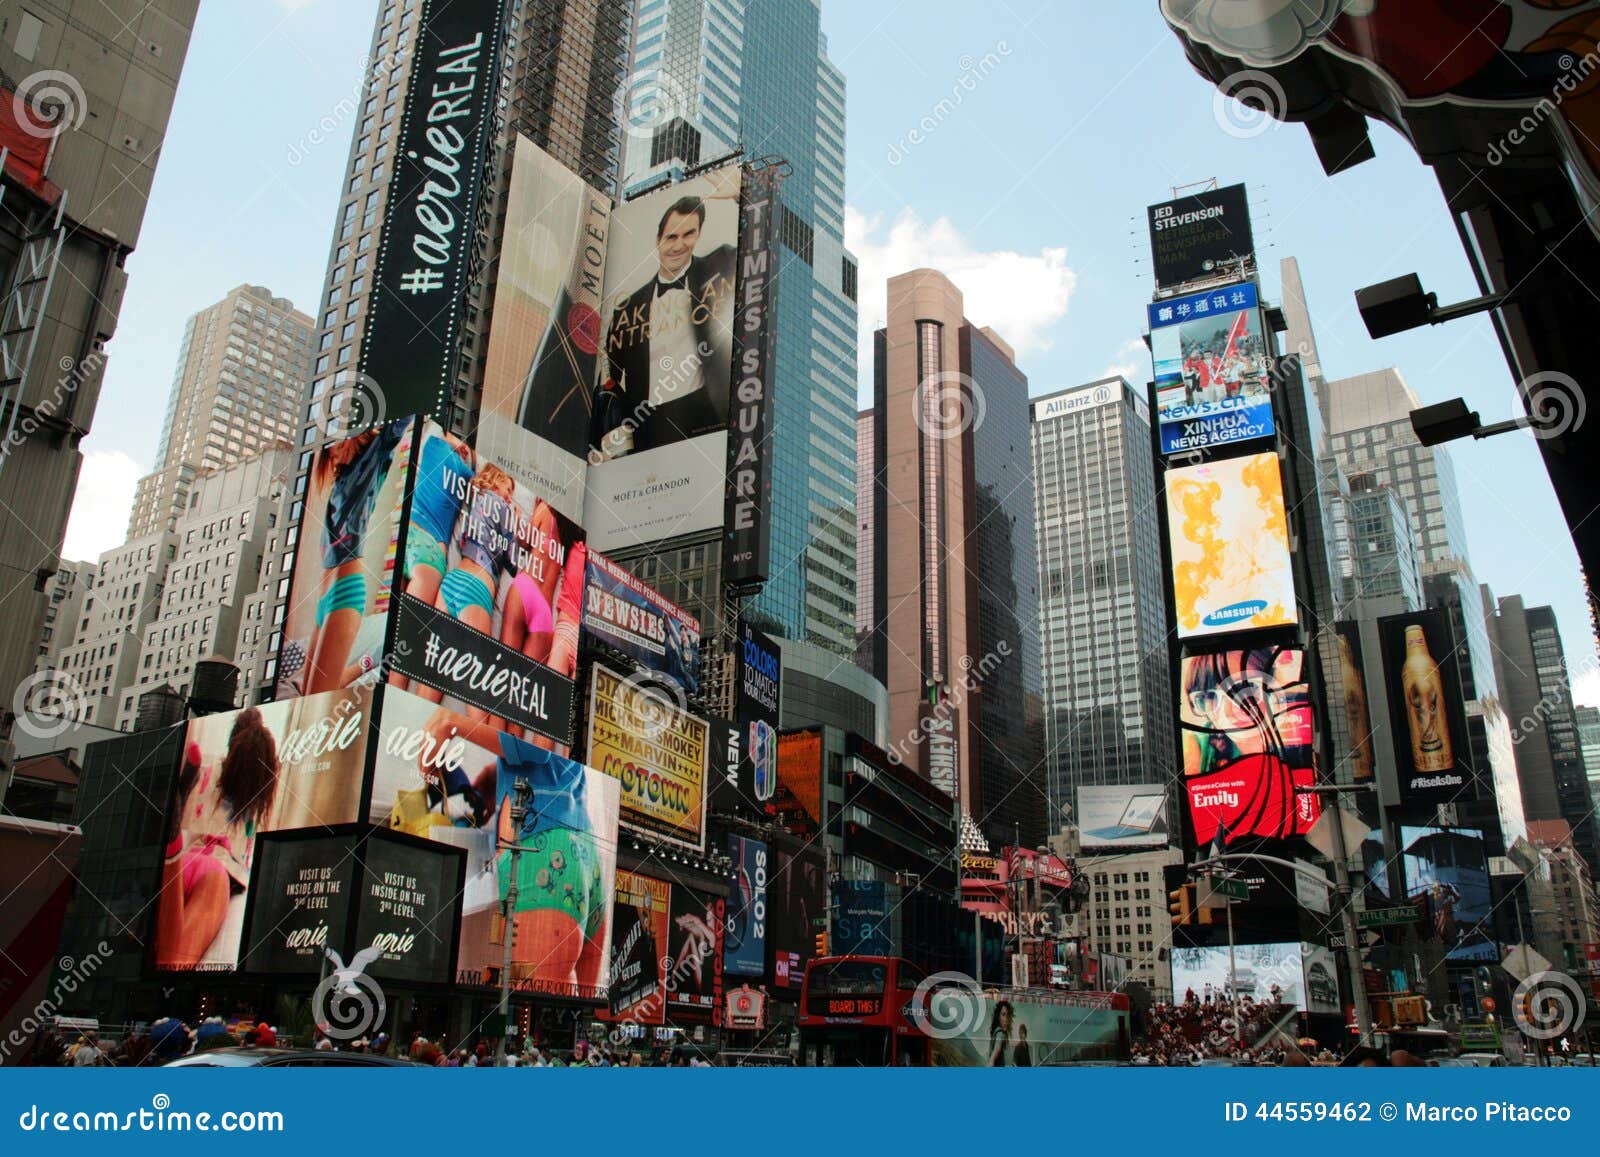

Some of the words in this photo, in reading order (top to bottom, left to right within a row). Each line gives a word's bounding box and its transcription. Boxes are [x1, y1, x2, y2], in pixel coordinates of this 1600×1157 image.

[400, 31, 483, 295] #aerieREAL
[1153, 205, 1174, 221] JED
[1155, 205, 1224, 231] STEVENSON
[743, 199, 769, 332] TIMES
[1158, 291, 1248, 322] 新华通讯社
[1046, 395, 1091, 415] Allianz
[1170, 433, 1208, 450] NEWS
[1210, 423, 1266, 445] AGENCY
[1184, 413, 1250, 436] XINHUA
[734, 348, 763, 531] SQUARE
[527, 471, 568, 497] CHANDON
[645, 476, 691, 496] CHANDON
[442, 466, 480, 504] VISIT
[482, 494, 501, 523] US
[504, 507, 547, 553] INSIDE
[548, 538, 565, 567] ON
[459, 511, 485, 546] THE
[489, 530, 508, 553] 3RD
[510, 545, 545, 583] LEVEL
[732, 551, 753, 563] NYC
[588, 550, 606, 569] FINAL
[630, 574, 643, 593] LAST
[586, 584, 666, 643] NEWSIES
[1210, 605, 1262, 621] SAMSUNG
[743, 640, 778, 682] COLORS
[425, 632, 549, 721] #aerieREAL
[744, 662, 754, 680] TO
[754, 670, 778, 699] MATCH
[278, 710, 363, 765] aerie
[385, 726, 466, 772] aerie
[655, 728, 701, 763] SMOKEY
[621, 732, 678, 771] MARVIN
[726, 728, 740, 789] NEW
[929, 716, 954, 798] RSHEY'S
[603, 753, 690, 815] MOTOWN
[1410, 775, 1463, 789] #RiseAsOne
[1193, 790, 1239, 808] Emily
[300, 868, 319, 881] VISIT
[320, 867, 332, 880] US
[384, 871, 404, 887] VISIT
[406, 877, 417, 890] US
[753, 849, 767, 922] SOLO
[287, 883, 313, 896] INSIDE
[313, 882, 325, 895] ON
[326, 880, 341, 893] THE
[371, 883, 399, 901] INSIDE
[399, 890, 411, 903] ON
[412, 893, 426, 907] THE
[306, 896, 329, 910] LEVEL
[393, 903, 415, 919] LEVEL
[1387, 908, 1419, 920] BRAZIL
[286, 919, 328, 949] aerie
[371, 927, 417, 953] aerie
[753, 922, 766, 940] 2
[829, 999, 856, 1015] BOARD
[857, 999, 874, 1014] THIS
